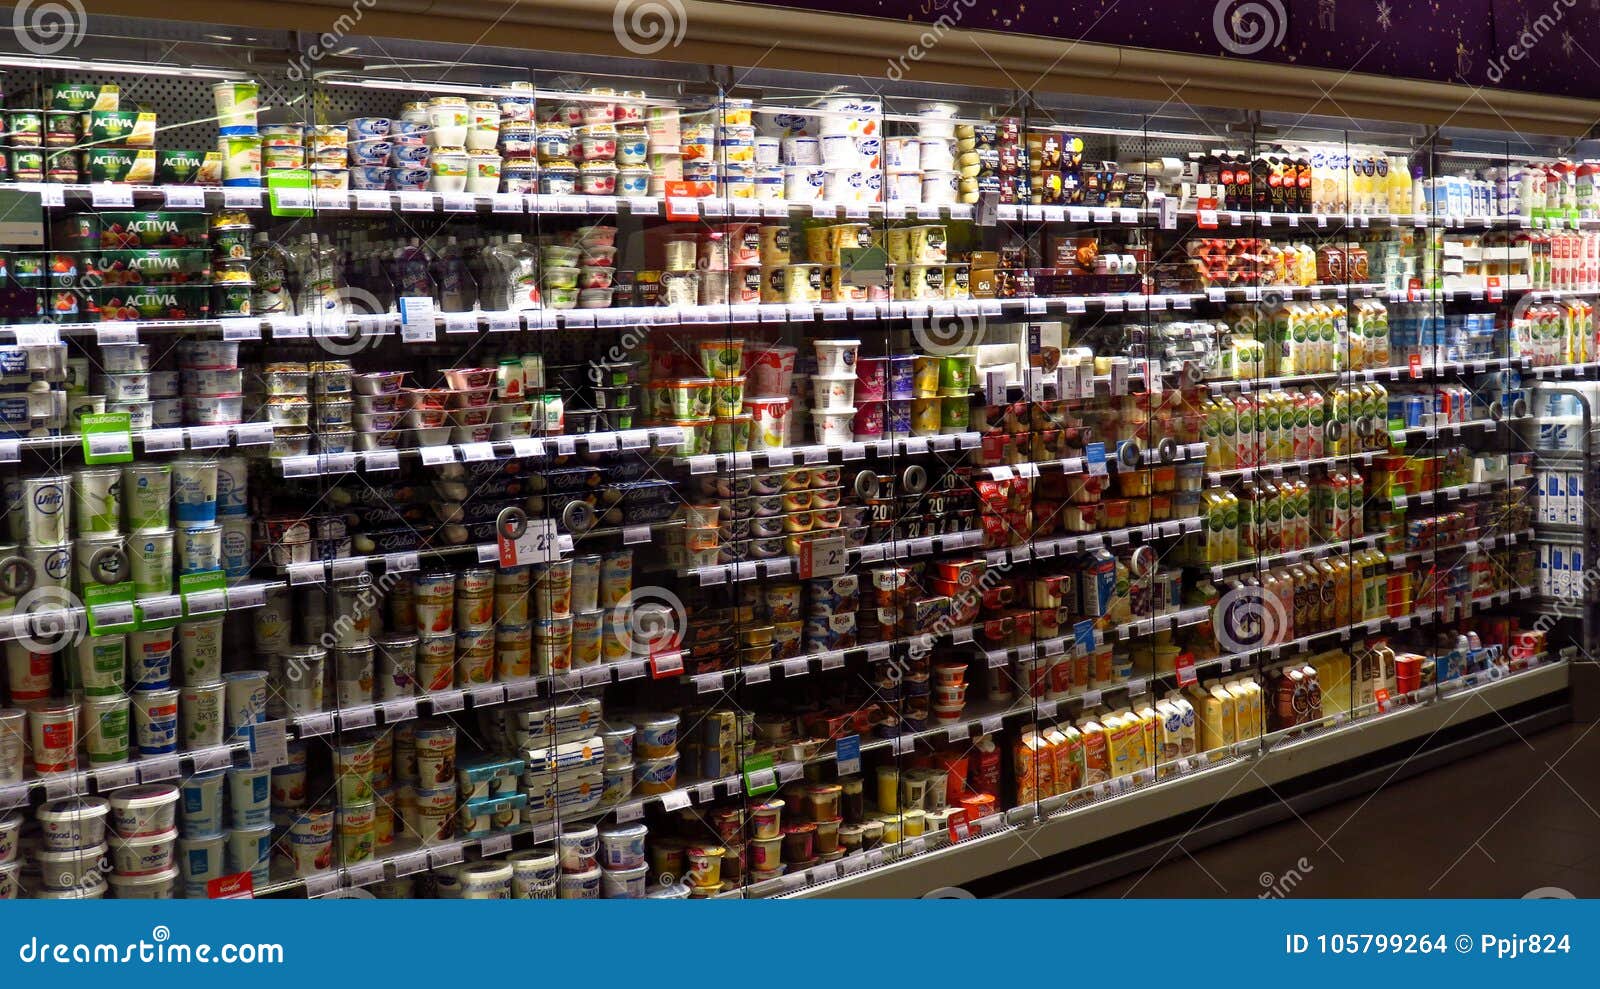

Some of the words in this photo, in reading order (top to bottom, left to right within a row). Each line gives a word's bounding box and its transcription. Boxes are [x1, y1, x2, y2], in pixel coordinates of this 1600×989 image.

[56, 90, 96, 100] ACTIVIA
[94, 117, 133, 128] ACTIVIA
[93, 155, 132, 166] ACTIVIA
[163, 157, 200, 167] ACTIVIA
[126, 221, 179, 233] ACTIVIA
[128, 257, 180, 269] ACTIVIA
[126, 295, 177, 307] ACTIVIA
[929, 498, 944, 513] 20
[872, 504, 887, 520] 20
